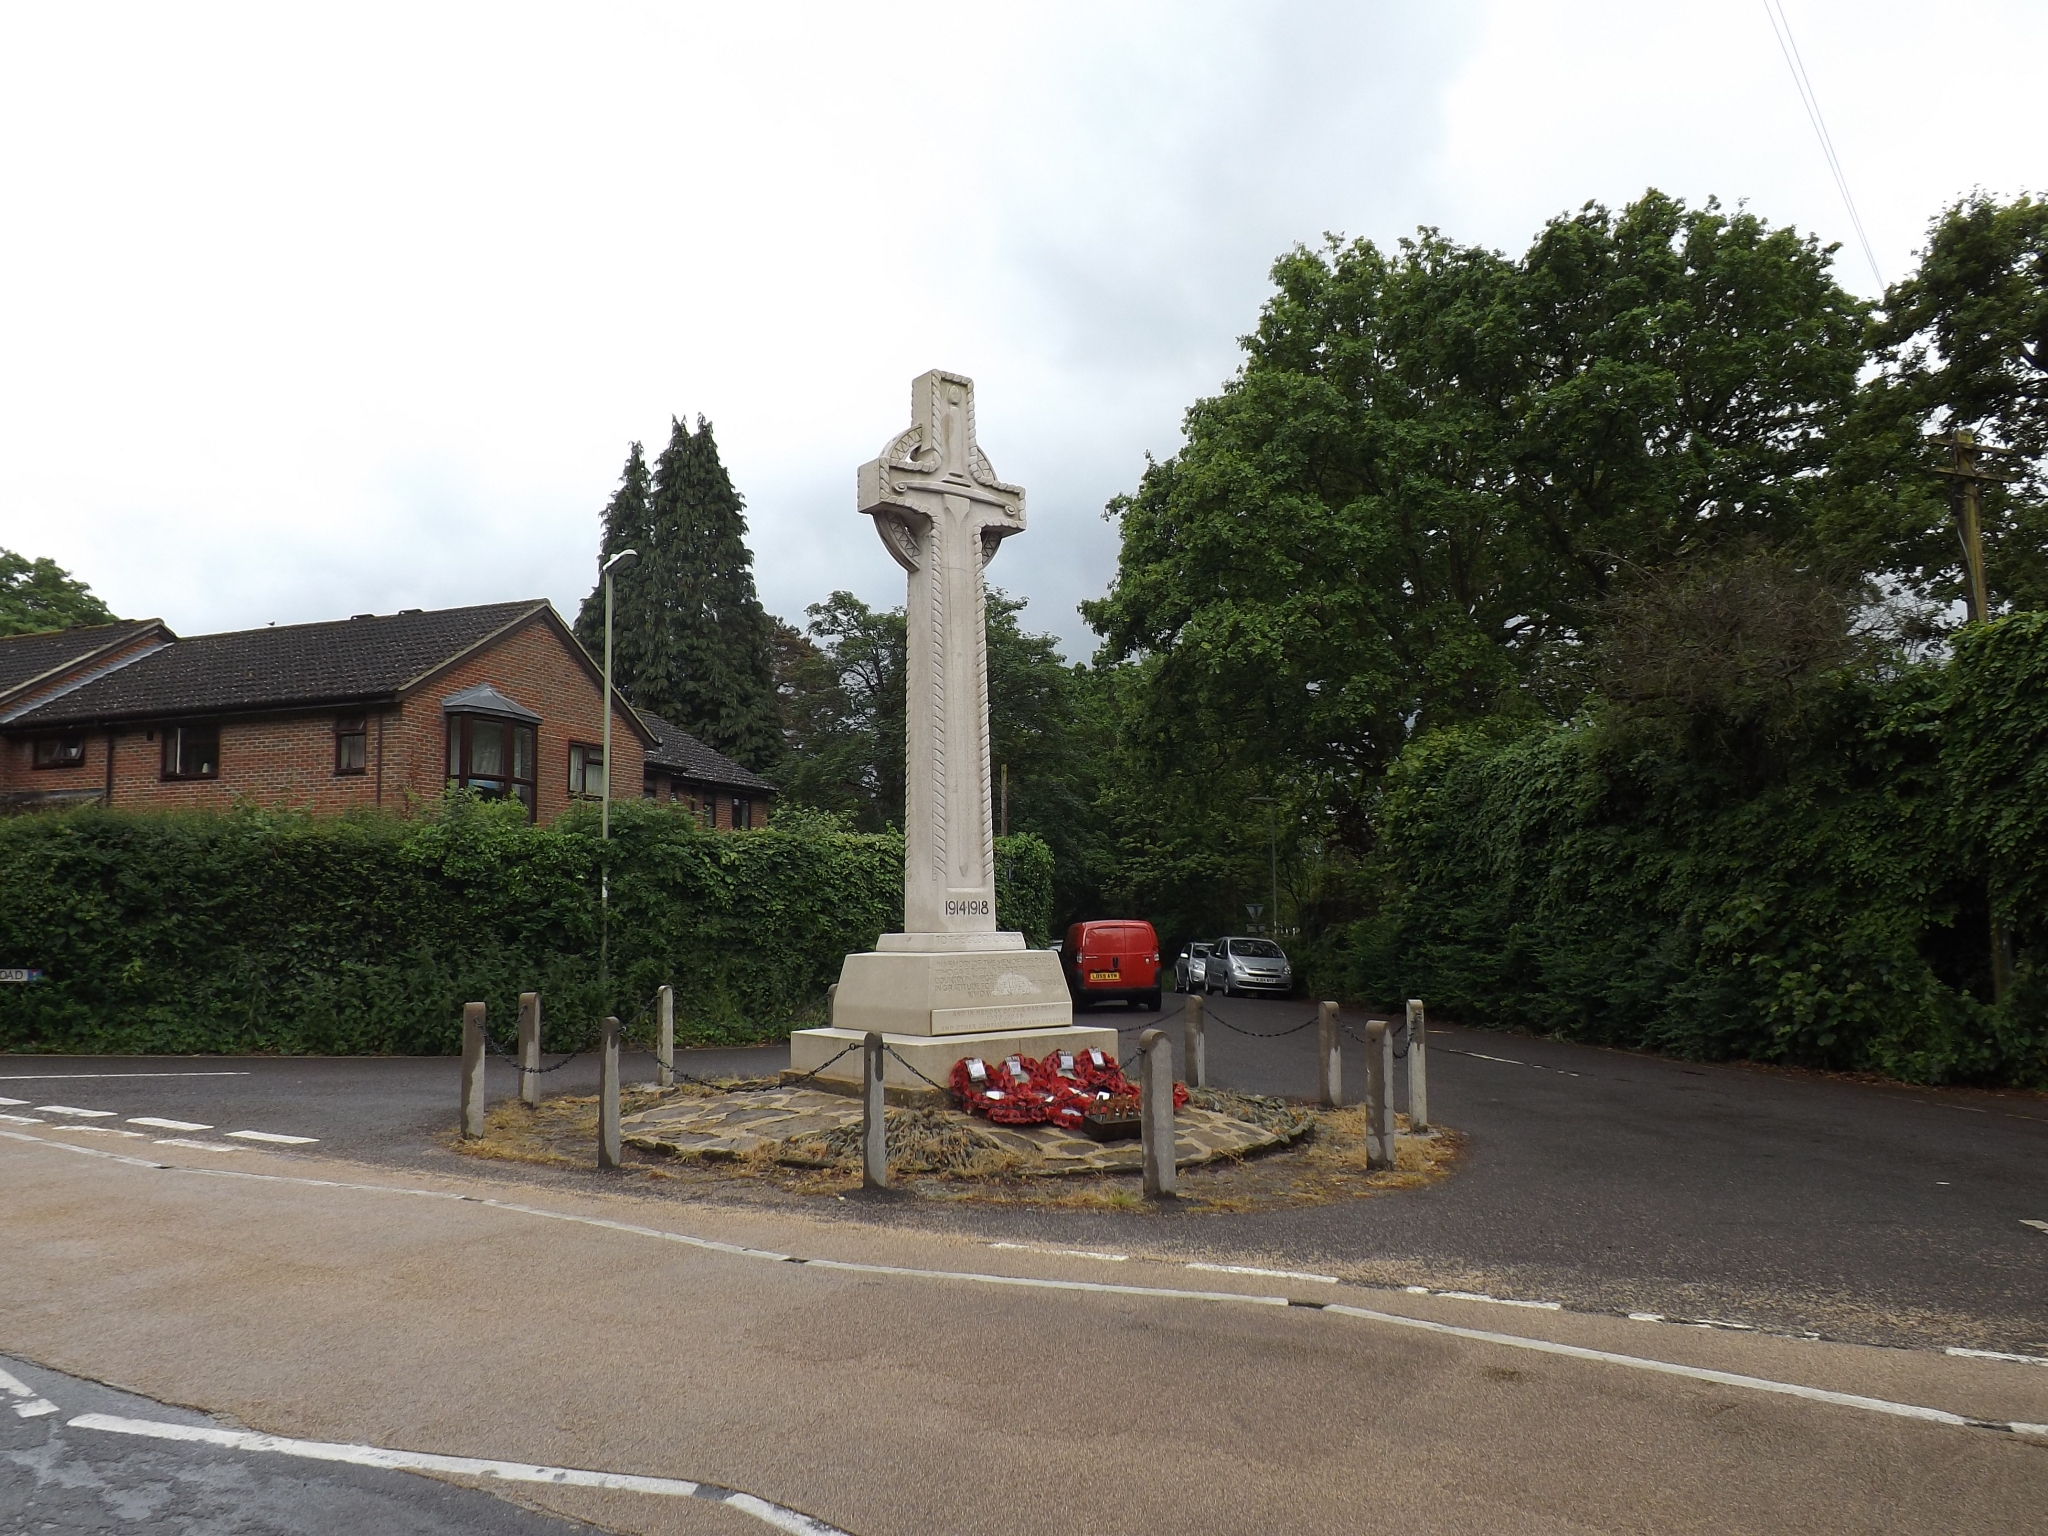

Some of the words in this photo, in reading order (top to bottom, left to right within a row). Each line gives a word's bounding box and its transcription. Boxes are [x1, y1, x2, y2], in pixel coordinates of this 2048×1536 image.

[935, 935, 947, 945] TO
[983, 959, 997, 967] THE
[935, 975, 964, 984] COUNTRY
[935, 984, 942, 992] IN
[942, 983, 981, 992] GRATITUDE
[967, 990, 985, 998] WHO
